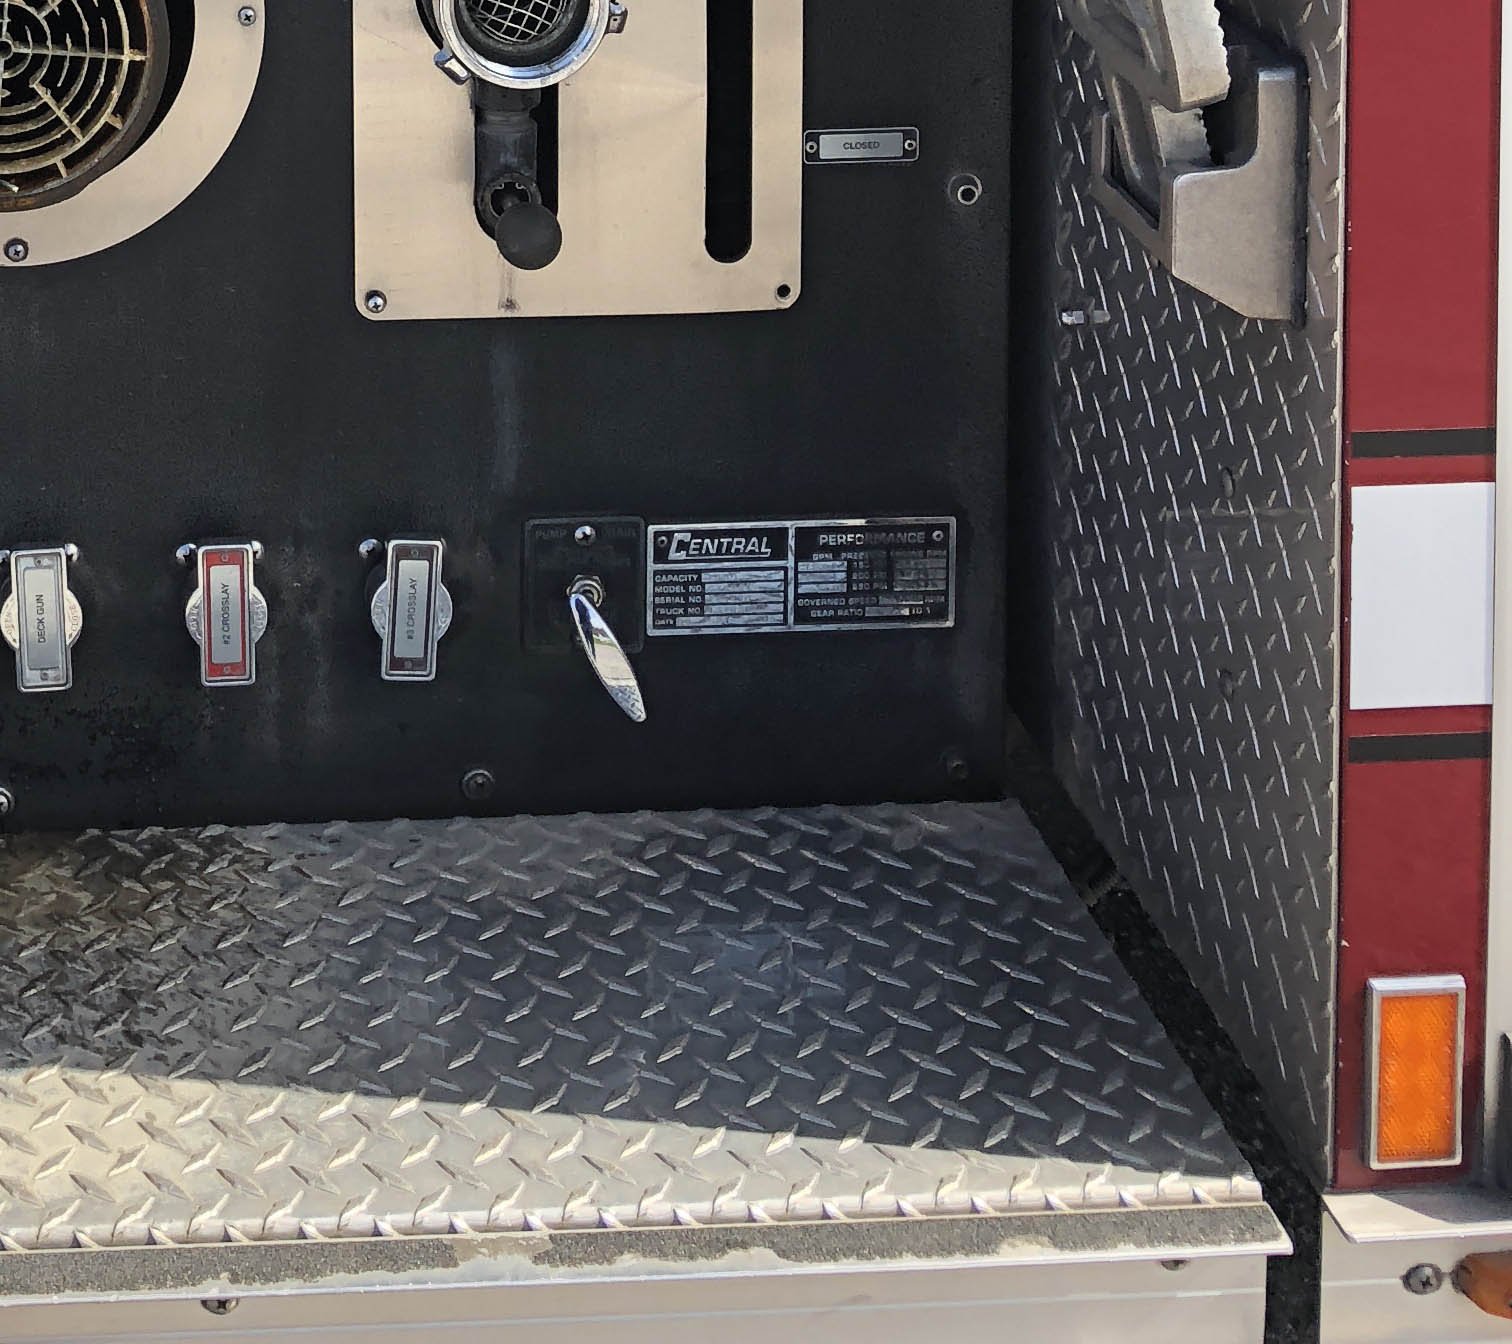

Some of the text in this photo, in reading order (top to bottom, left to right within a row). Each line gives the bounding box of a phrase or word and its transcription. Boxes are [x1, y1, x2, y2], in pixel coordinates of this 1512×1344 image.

[843, 141, 880, 150] CLOSED
[668, 533, 772, 560] CENTRAL
[820, 532, 925, 545] PERFORMANCE
[36, 594, 46, 643] DECK GUN
[221, 583, 230, 645] #2 CROSSLAY
[407, 577, 417, 640] #3 CROSSLAY
